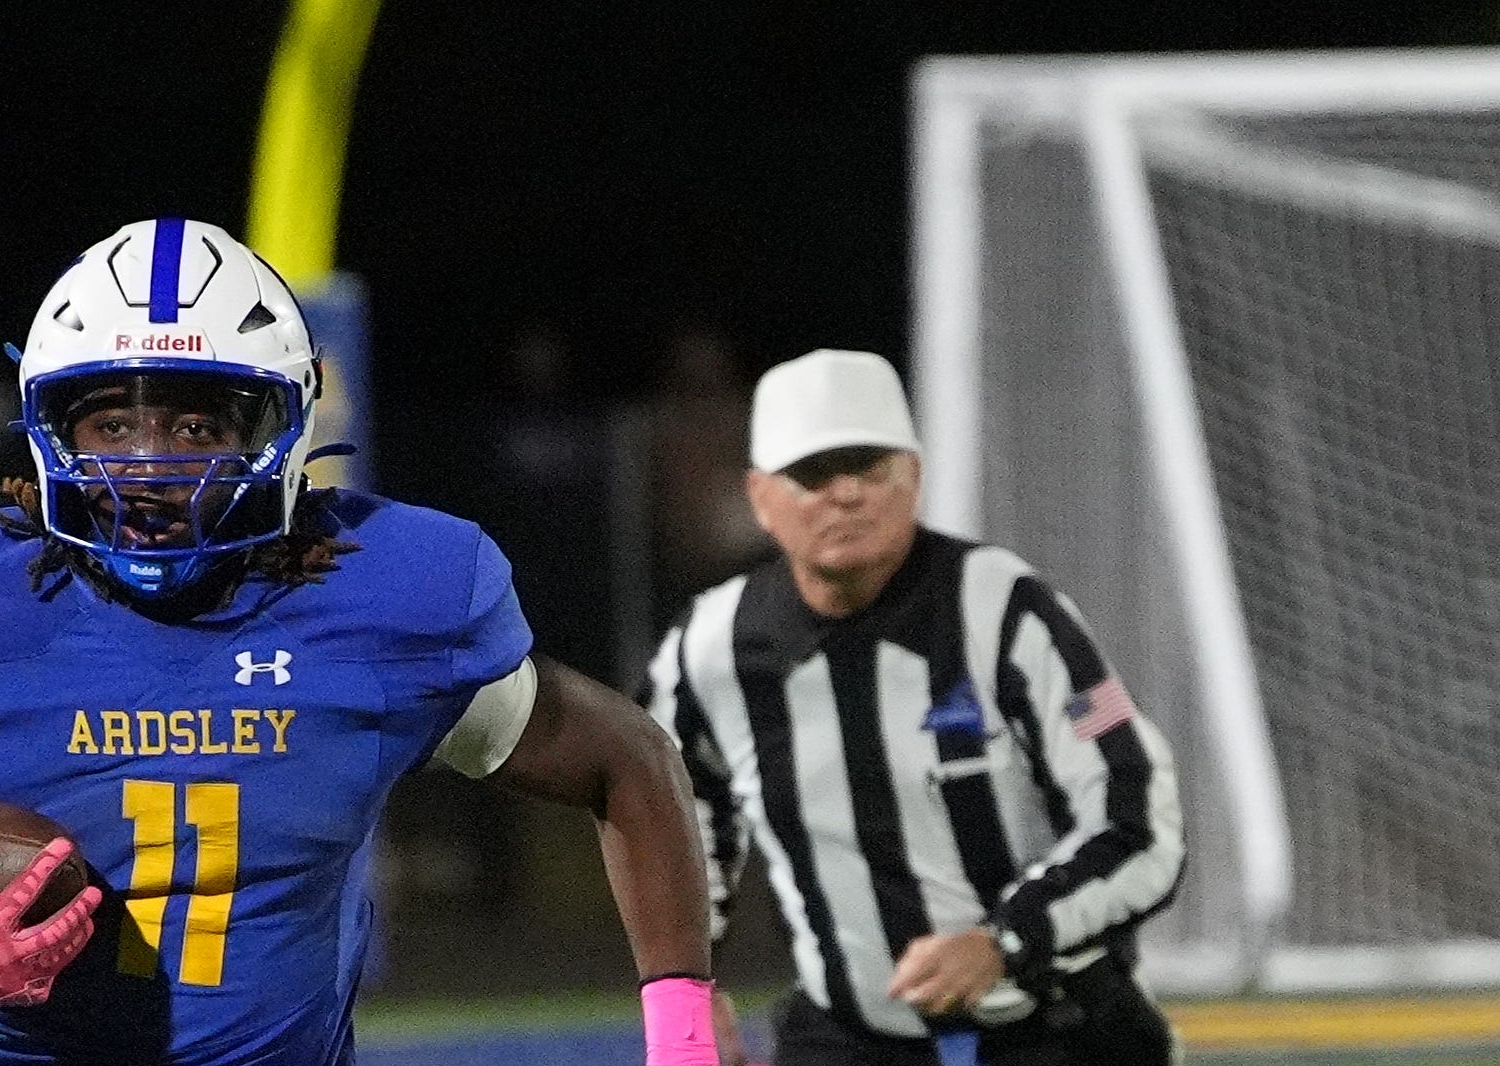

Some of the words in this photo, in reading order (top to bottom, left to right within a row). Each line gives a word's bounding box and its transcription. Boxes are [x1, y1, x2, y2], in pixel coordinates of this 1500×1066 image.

[116, 334, 202, 352] Rddell
[67, 709, 297, 755] ARDSLEY
[117, 779, 240, 986] 11
